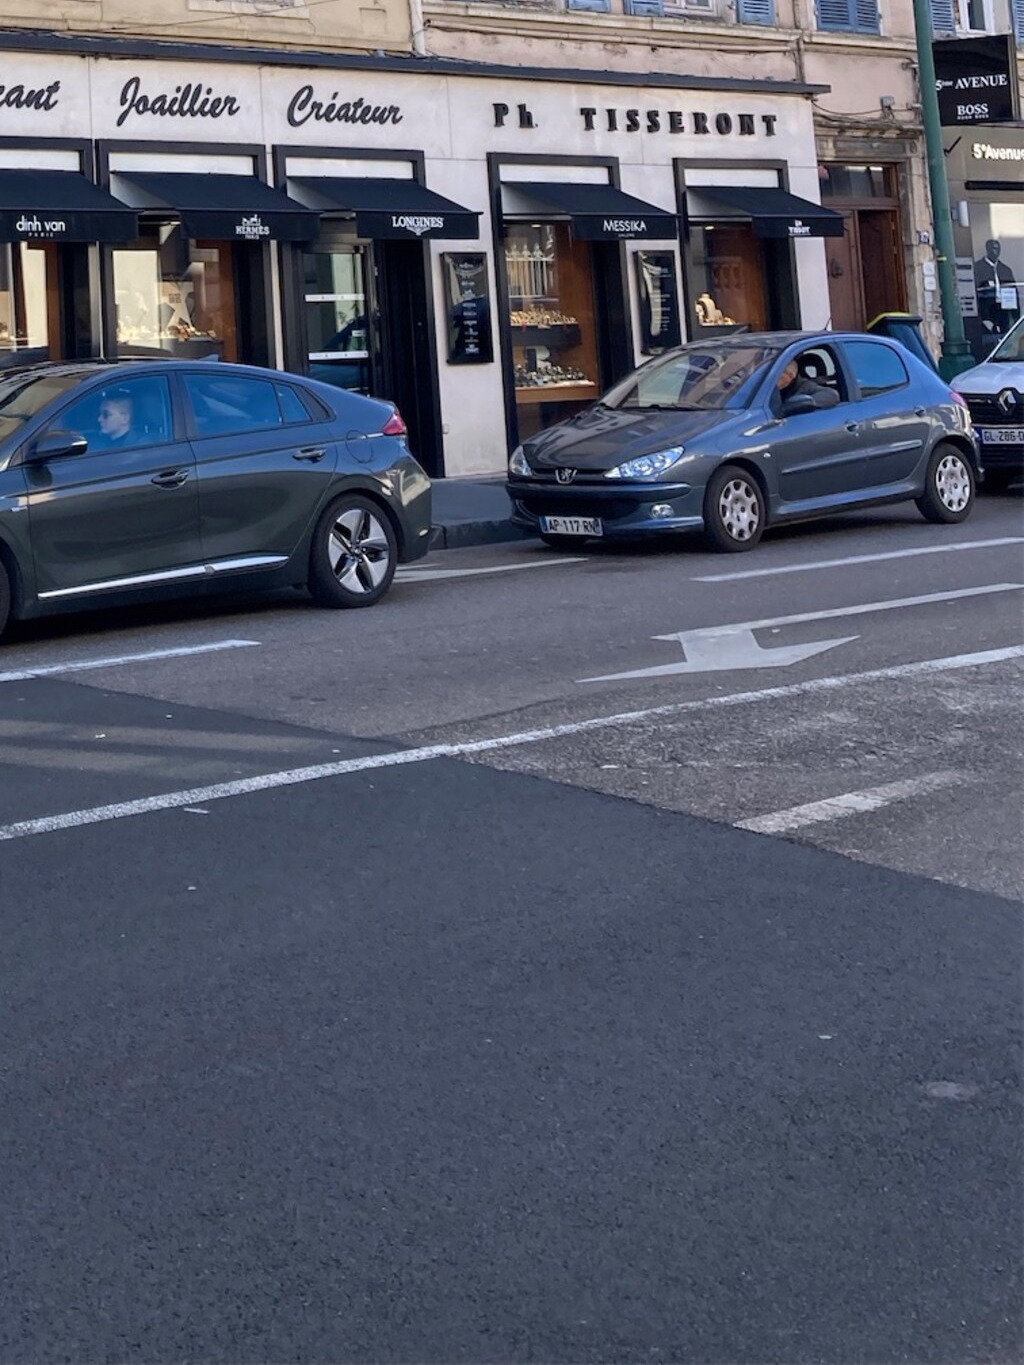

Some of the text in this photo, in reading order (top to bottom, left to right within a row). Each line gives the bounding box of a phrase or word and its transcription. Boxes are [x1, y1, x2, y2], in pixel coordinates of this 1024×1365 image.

[955, 74, 1008, 90] AVENUE
[116, 76, 241, 127] Joaillier
[286, 84, 403, 128] Créateur
[957, 103, 989, 115] BOSS
[580, 108, 777, 137] TISSERONT
[16, 215, 65, 231] dinh van
[391, 216, 444, 228] LONGINES
[603, 219, 647, 232] MESSIKA
